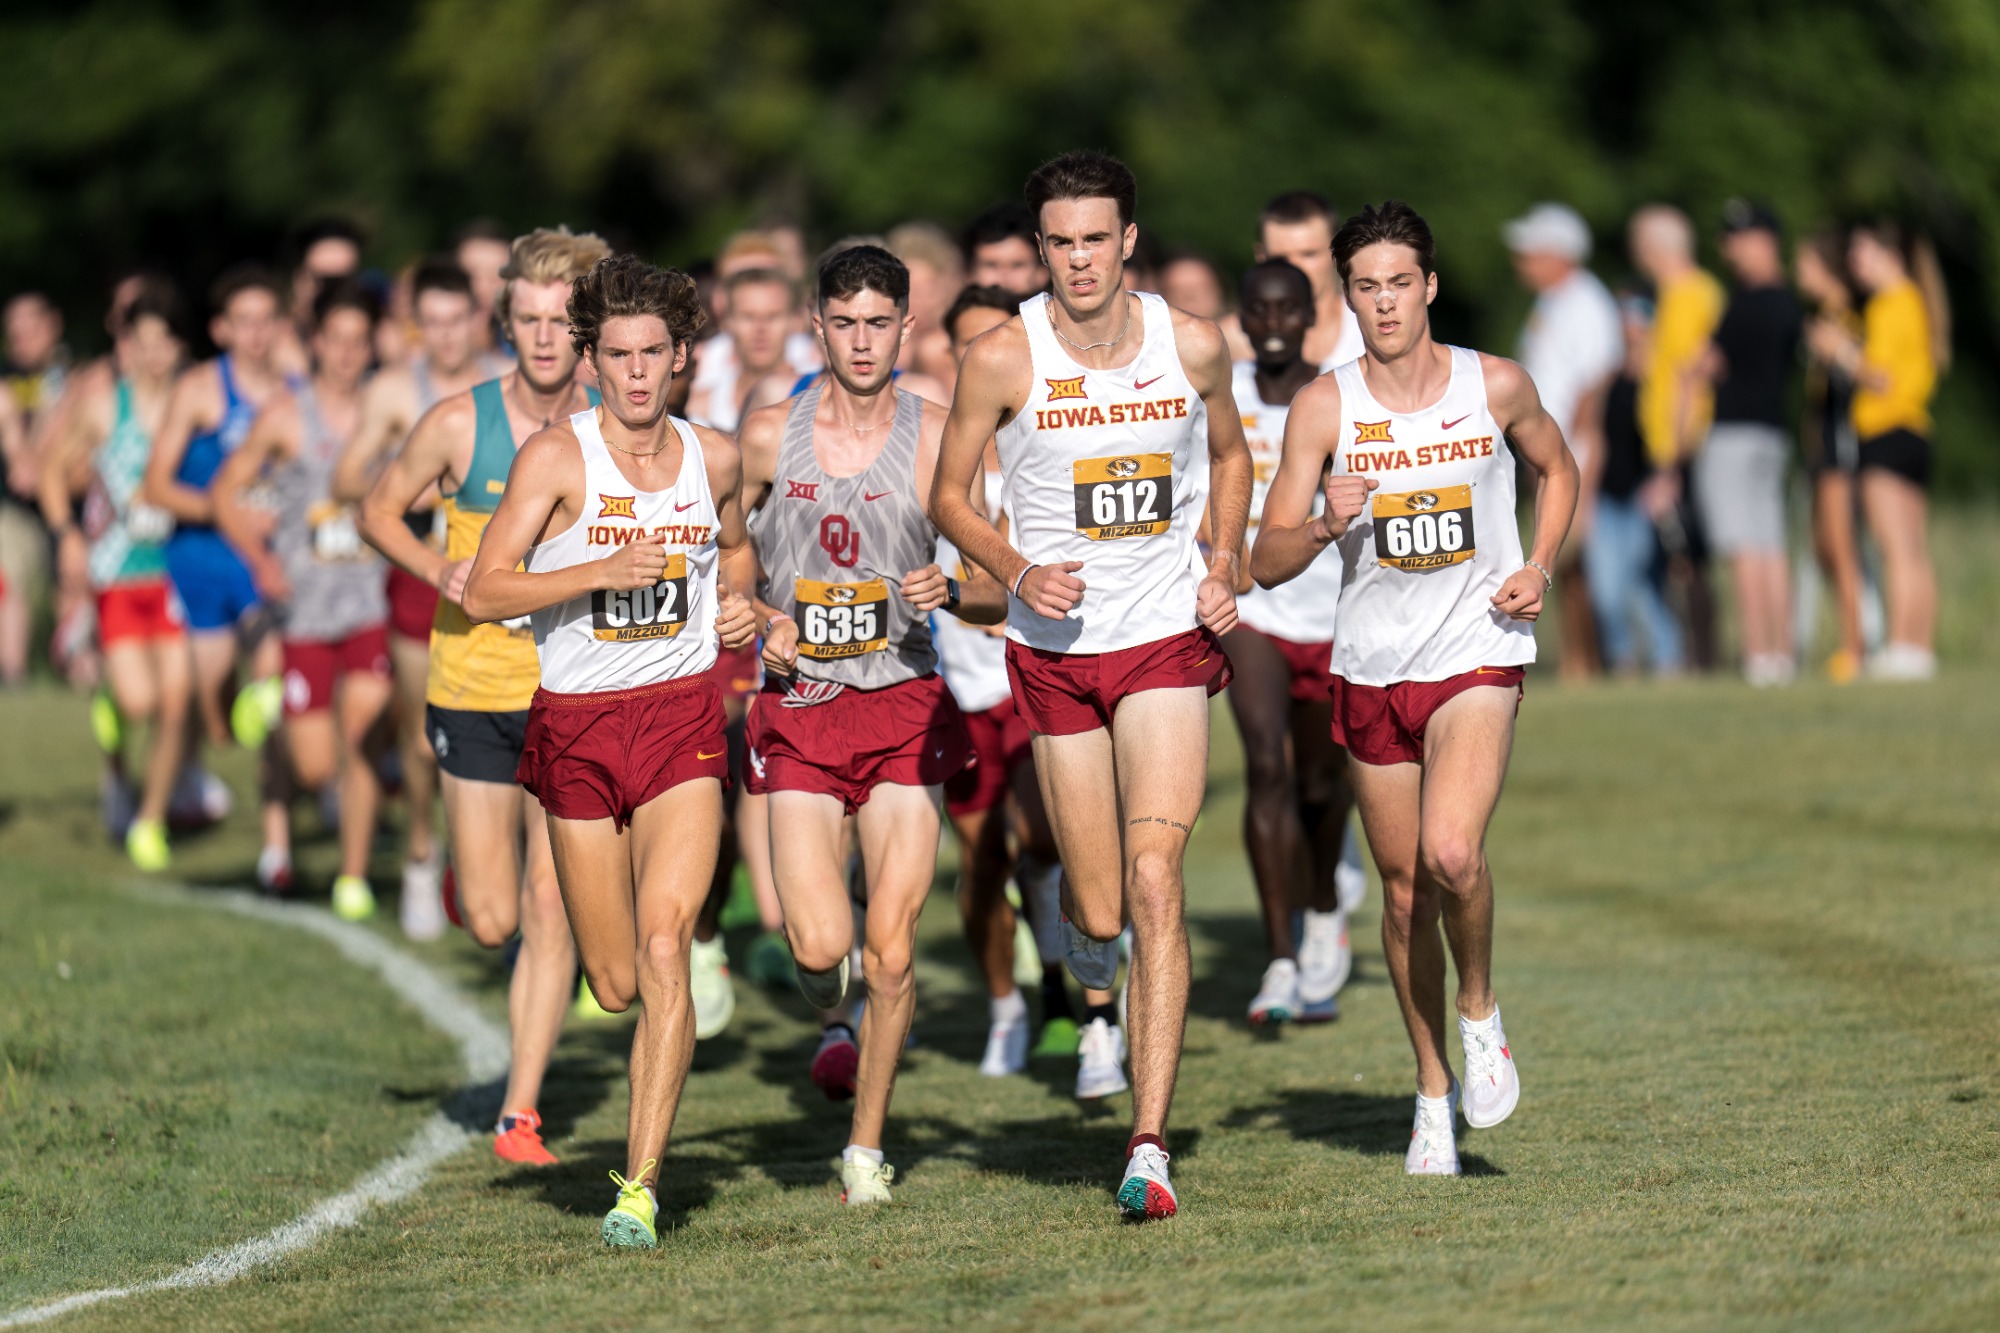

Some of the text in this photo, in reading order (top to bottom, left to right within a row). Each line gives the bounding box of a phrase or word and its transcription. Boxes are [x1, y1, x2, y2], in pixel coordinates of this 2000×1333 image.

[1036, 396, 1187, 431] IOWA STATE
[1346, 436, 1493, 473] IOWA STATE
[785, 479, 819, 502] XII
[1092, 479, 1158, 525] 612
[588, 524, 711, 546] IOWA STATE
[819, 514, 860, 567] OU
[1099, 523, 1154, 539] MIZZOU
[1386, 511, 1464, 557] 606
[1400, 553, 1454, 568] MIZZOU
[605, 580, 678, 628] 602
[616, 625, 669, 640] MIZZOU
[804, 603, 877, 644] 635
[814, 643, 867, 656] MIZZOU
